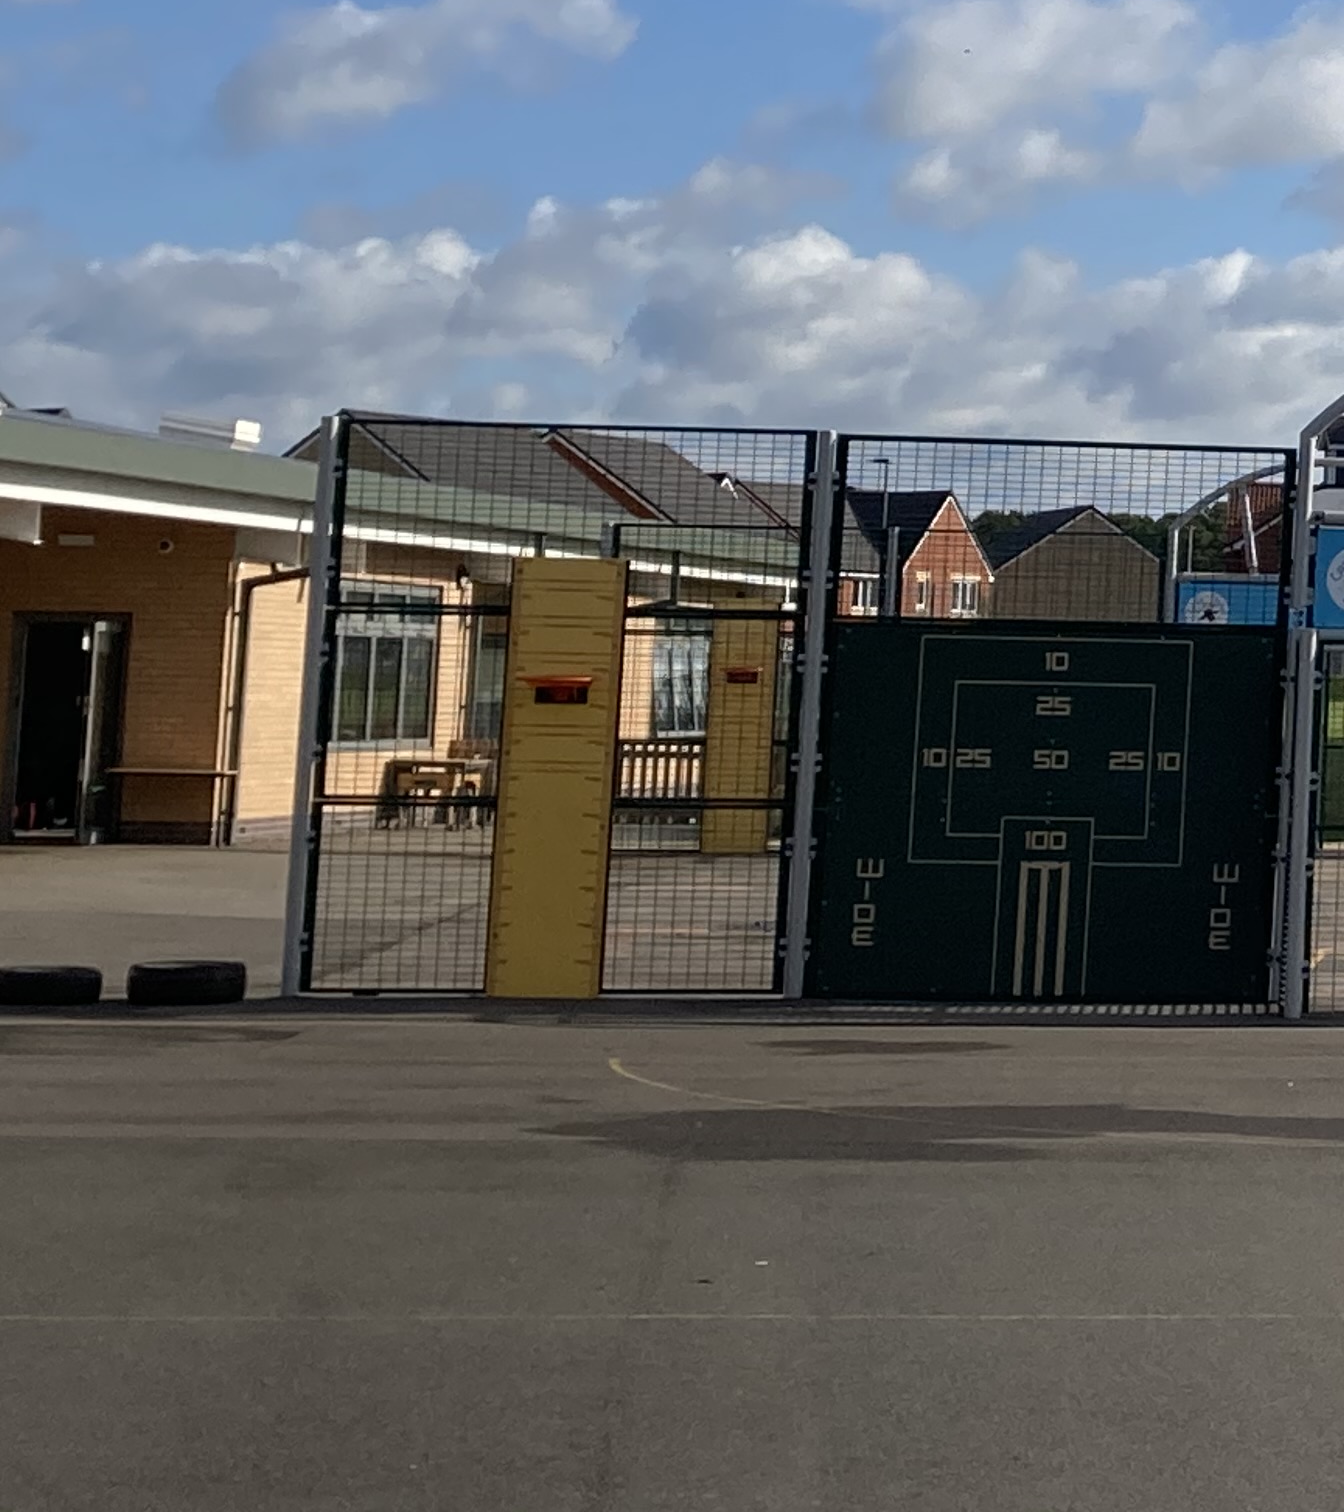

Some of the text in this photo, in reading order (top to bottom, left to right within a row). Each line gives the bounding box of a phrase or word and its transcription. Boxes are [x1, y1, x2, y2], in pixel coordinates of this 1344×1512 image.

[1045, 651, 1069, 671] 10
[1035, 696, 1071, 717] 25
[921, 748, 1180, 772] 10 25 50 25 10
[1024, 830, 1067, 851] 100
